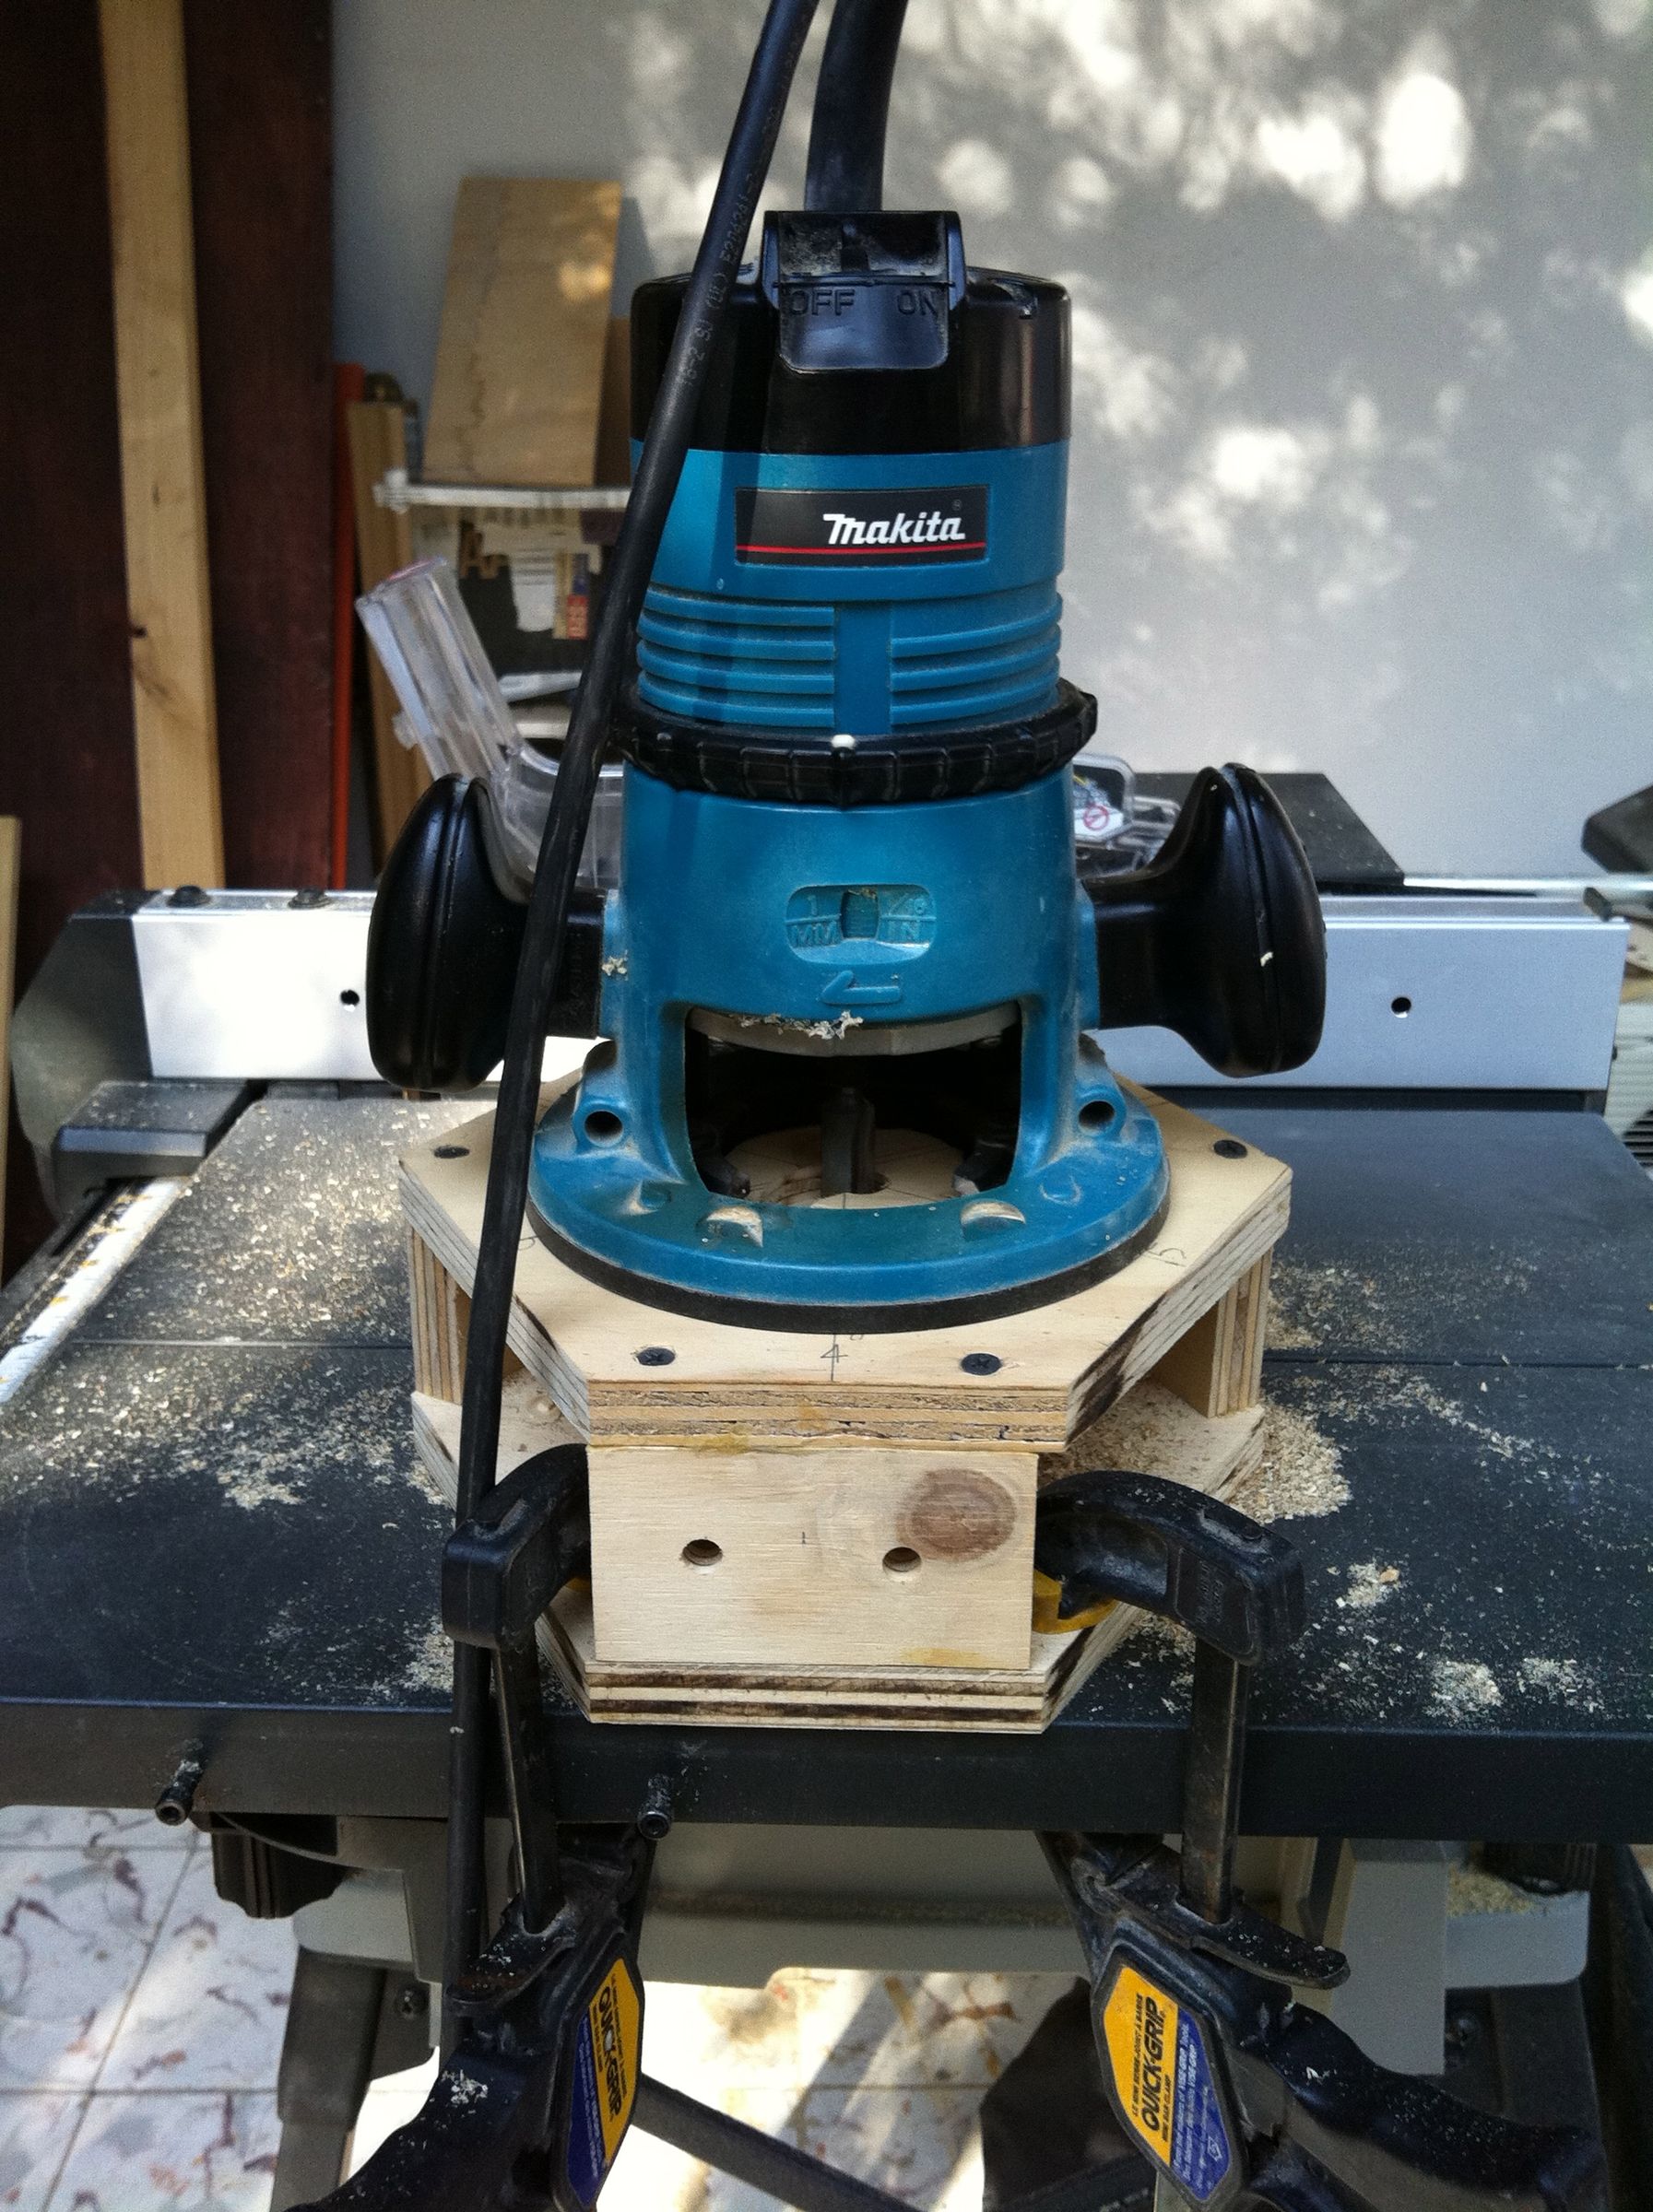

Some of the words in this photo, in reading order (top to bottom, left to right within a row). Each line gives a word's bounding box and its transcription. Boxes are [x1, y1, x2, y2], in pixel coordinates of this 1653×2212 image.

[789, 288, 856, 316] OFF
[897, 288, 939, 316] ON
[820, 1343, 849, 1363] 4
[1141, 1996, 1163, 2131] QUICK-GRIP
